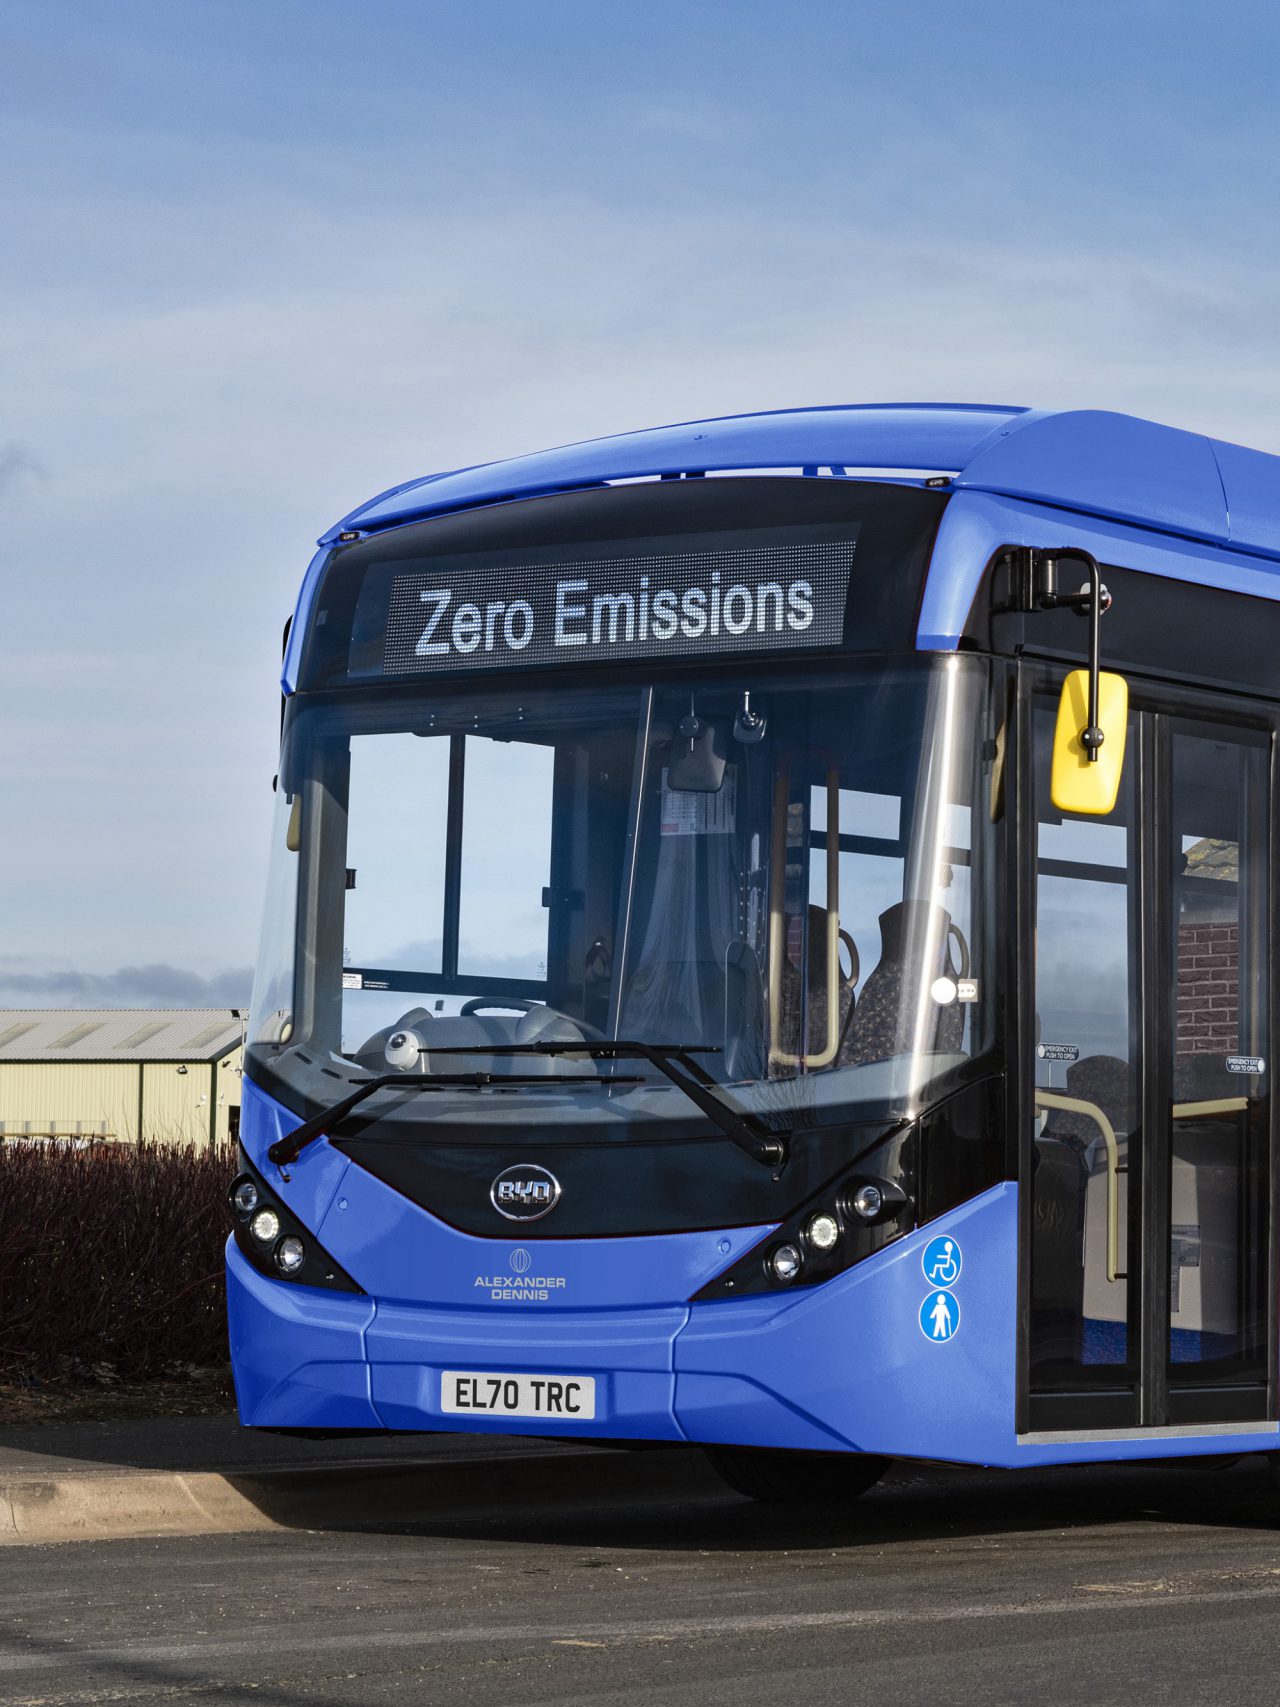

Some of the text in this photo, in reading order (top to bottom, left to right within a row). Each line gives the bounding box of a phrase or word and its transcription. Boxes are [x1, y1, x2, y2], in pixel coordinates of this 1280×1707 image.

[415, 570, 815, 656] Zero Emissions
[1044, 1045, 1069, 1053] EMERGENCY
[498, 1180, 551, 1204] BYD
[474, 1276, 566, 1288] ALEXANDER
[491, 1289, 549, 1300] DENNIS
[456, 1378, 581, 1412] EL70 TRC
